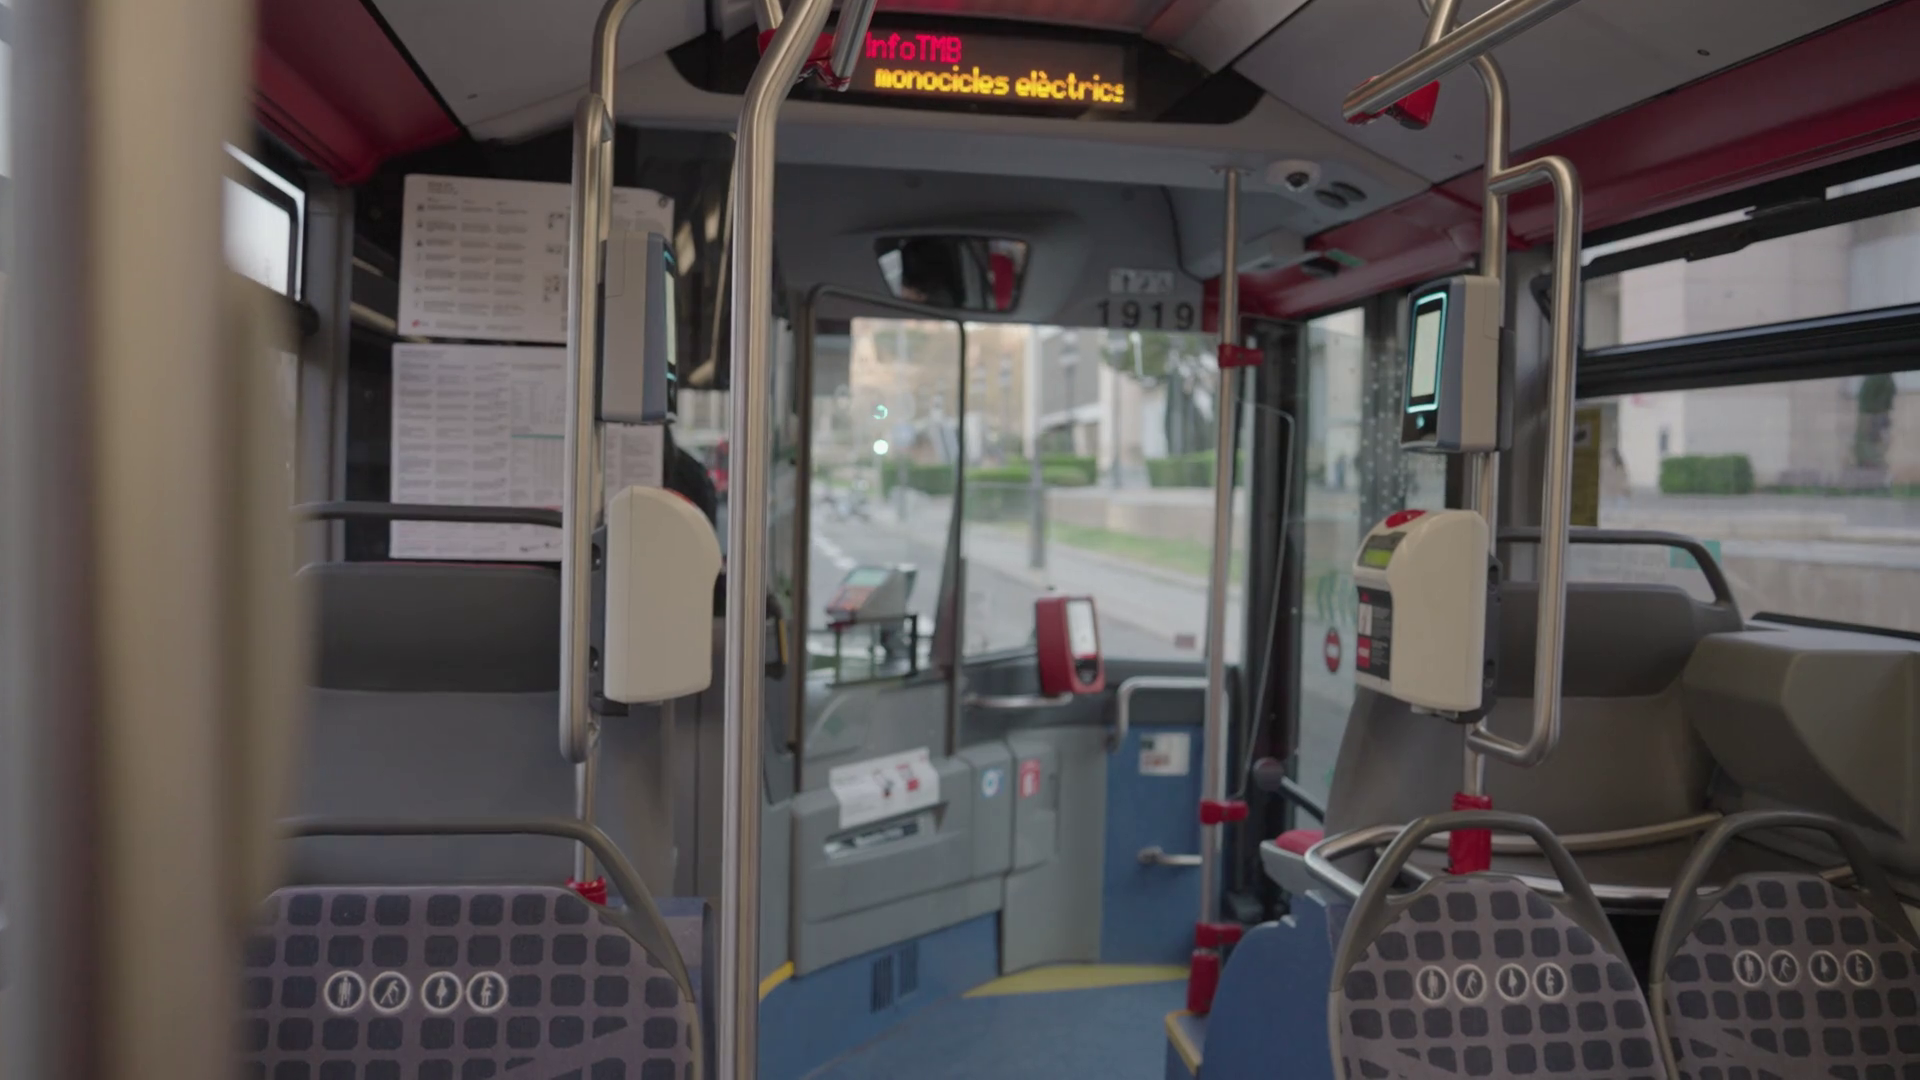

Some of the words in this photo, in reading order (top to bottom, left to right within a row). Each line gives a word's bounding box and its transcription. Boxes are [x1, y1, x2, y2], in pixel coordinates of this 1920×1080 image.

[865, 31, 962, 63] InfoTMB
[874, 65, 1010, 96] monocicles
[1014, 70, 1124, 103] elèctrics
[1098, 299, 1195, 330] 1919
